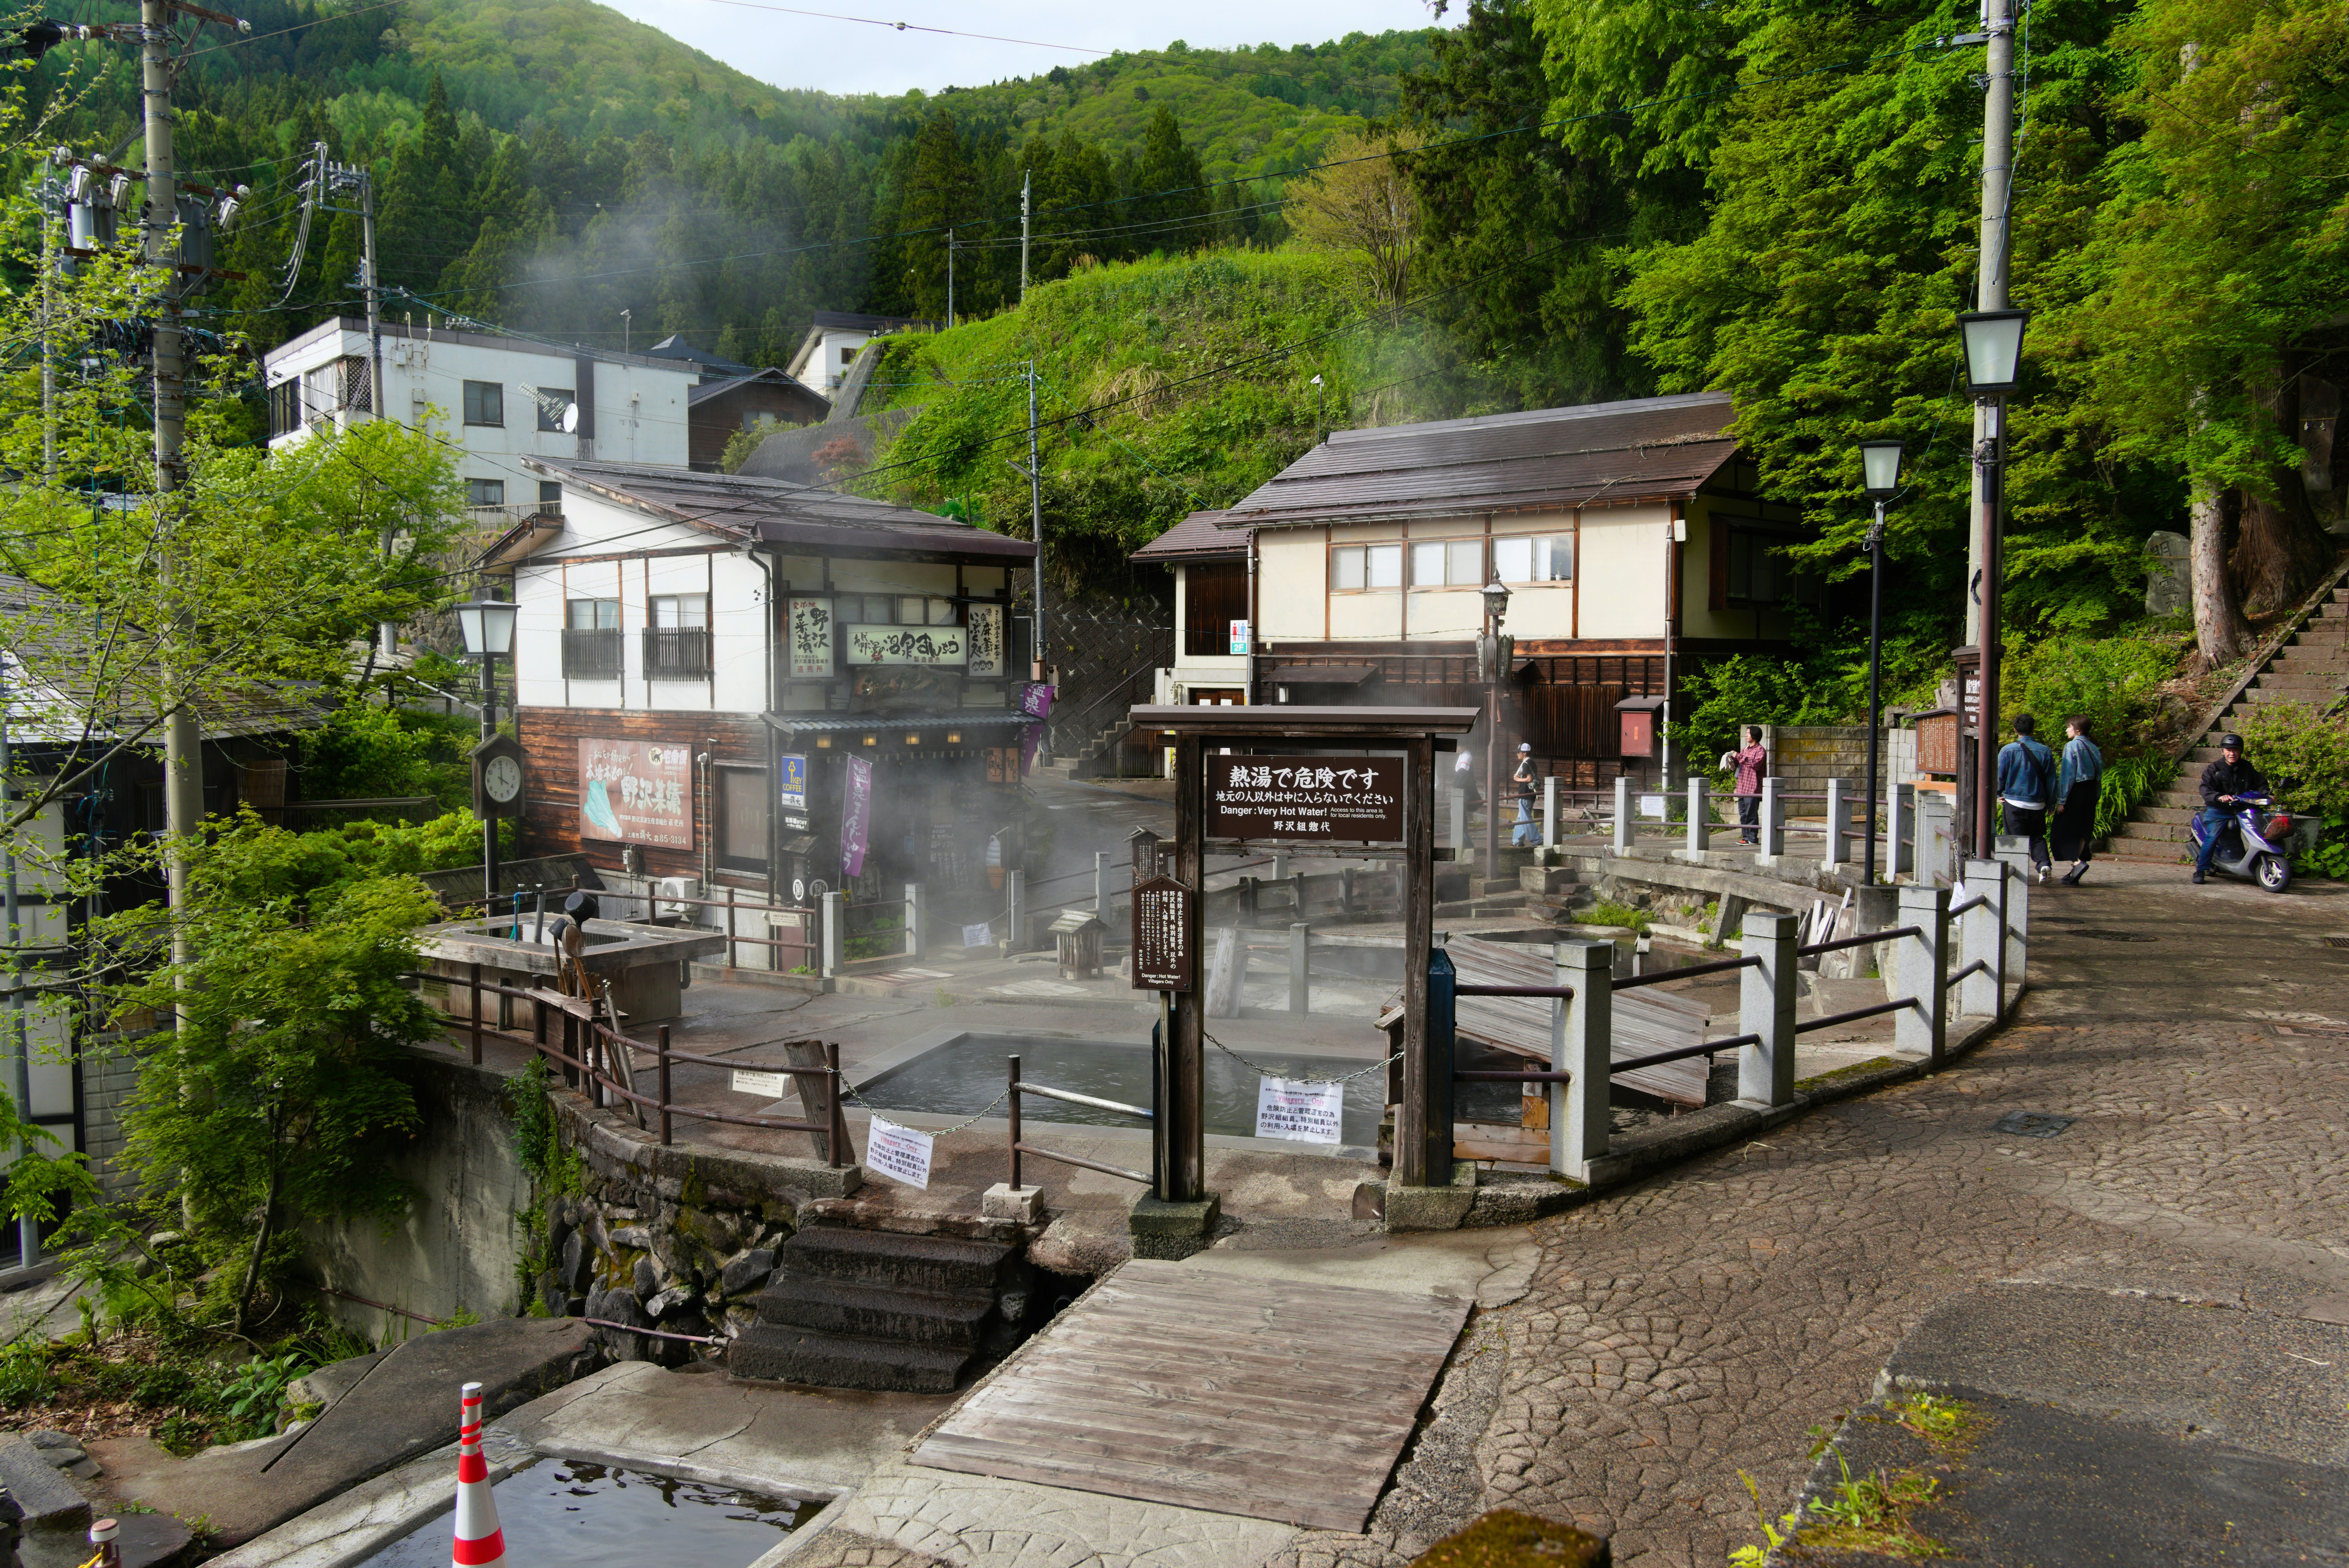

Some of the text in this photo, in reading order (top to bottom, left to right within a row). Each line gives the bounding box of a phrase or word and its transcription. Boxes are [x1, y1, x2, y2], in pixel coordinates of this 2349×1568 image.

[793, 601, 816, 609] 発祥の地
[810, 608, 830, 648] 野沢
[663, 749, 688, 764] 宅急便
[1230, 766, 1379, 789] 熱湯で危険です
[783, 783, 802, 792] COFFEE
[621, 775, 684, 816] 野沢菜漬
[1215, 791, 1393, 804] 地元の人以外は中に入らないでください
[843, 764, 868, 870] 温泉まんじゅう
[1280, 807, 1296, 815] Hot
[1298, 807, 1327, 816] Water!
[668, 818, 684, 827] 直売所
[1273, 821, 1331, 832] 野沢組惣代
[1278, 1095, 1325, 1106] Villagers Only
[1266, 1105, 1335, 1118] 危険防止と管理運営の為
[1261, 1113, 1338, 1127] 野沢組組員、特別組員以外
[1260, 1122, 1335, 1136] の利用・入場を禁止します。
[880, 1136, 901, 1147] Villagers
[906, 1144, 918, 1152] Only
[873, 1141, 925, 1165] 危険防止と管理運営の為
[870, 1147, 927, 1174] 野沢組組員、特別組員以外
[870, 1155, 923, 1180] の利用・入場を禁止します。
